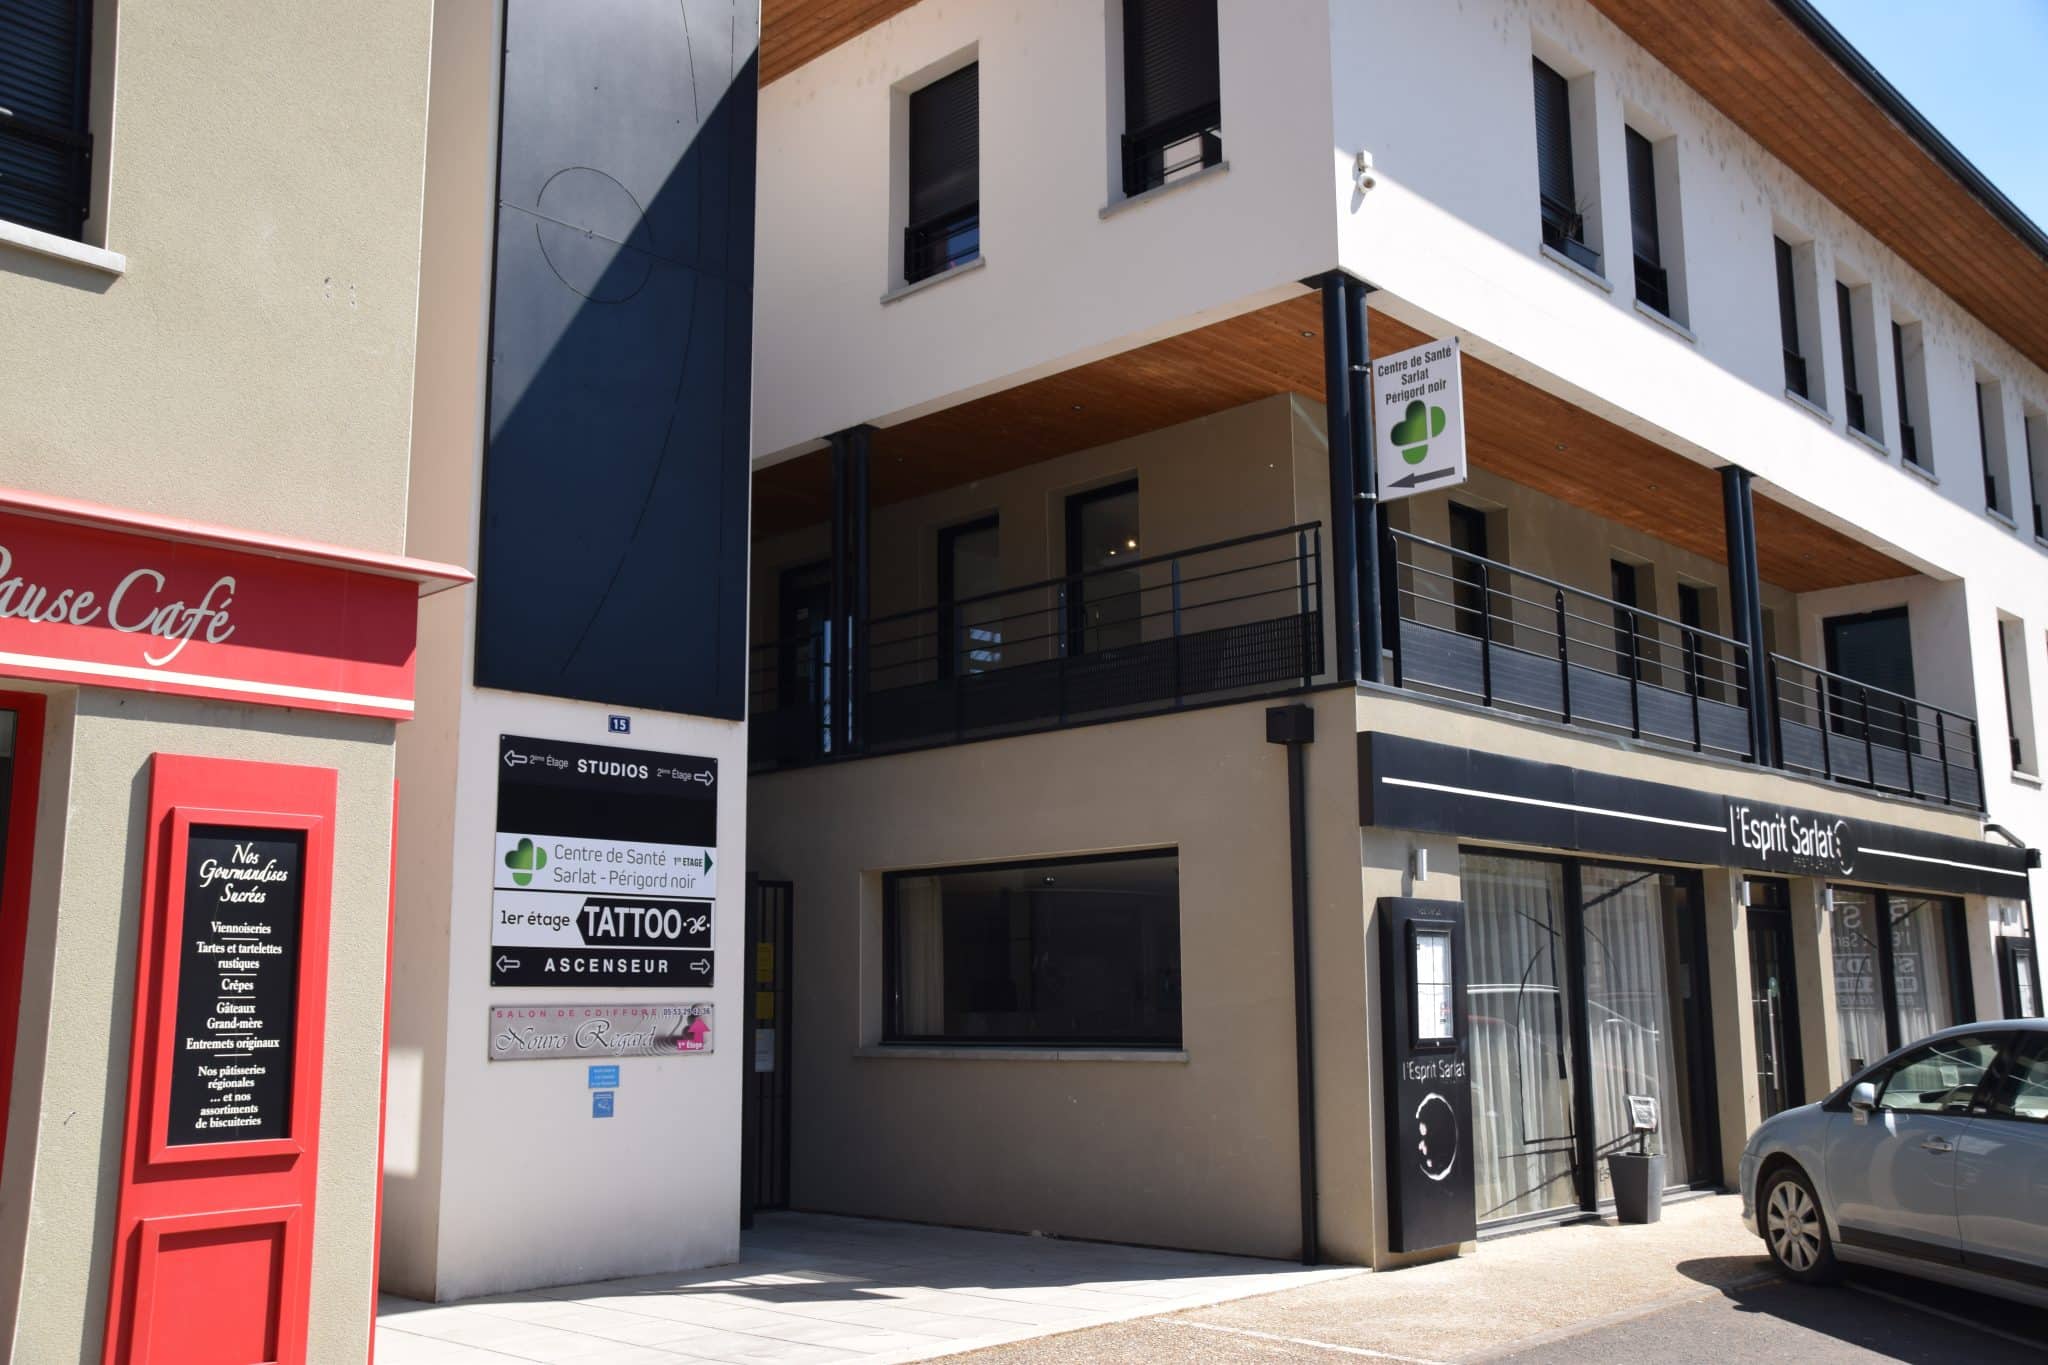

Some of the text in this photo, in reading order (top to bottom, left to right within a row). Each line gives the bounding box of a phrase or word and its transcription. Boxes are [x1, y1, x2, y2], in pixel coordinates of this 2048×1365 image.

[1378, 346, 1452, 377] Centre de Santé
[1401, 368, 1429, 386] Sarlat
[1385, 379, 1447, 405] Périgord noir
[107, 568, 236, 667] Café
[613, 718, 627, 731] 15
[546, 757, 569, 769] Étage
[577, 758, 649, 779] STUDIOS
[672, 769, 692, 781] Étage
[1730, 804, 1835, 861] l'Esprit Sarlat
[232, 842, 260, 864] Nos
[554, 844, 666, 866] Centre de Santé
[200, 858, 288, 887] Gourmandises
[553, 867, 597, 885] Sarlat
[609, 870, 667, 890] Périgord
[671, 874, 697, 889] noir
[220, 883, 267, 903] Sucrées
[211, 921, 271, 934] Viennoiseries
[501, 910, 524, 925] 1er
[527, 911, 570, 932] étage
[584, 905, 682, 940] TATTOO
[196, 941, 282, 954] Tartes et tartelettes
[218, 957, 260, 972] rustiques
[544, 957, 669, 973] ASCENSEUR
[221, 978, 254, 993] Crêpes
[216, 1002, 256, 1014] Gâteaux
[496, 1009, 547, 1018] SALON
[558, 1009, 575, 1017] DE
[584, 1008, 657, 1017] COIFFURE
[207, 1016, 263, 1029] Grand-mère
[186, 1037, 280, 1050] Entremets originaux
[496, 1018, 657, 1057] Nouvo Regard
[198, 1065, 266, 1078] Nos pâtisseries
[1403, 1060, 1466, 1084] l'Esprit Sarlat
[208, 1077, 255, 1091] régionales
[223, 1092, 233, 1102] et
[234, 1093, 251, 1102] nos
[200, 1104, 259, 1116] assortiments
[195, 1116, 262, 1129] de biscuiteries
